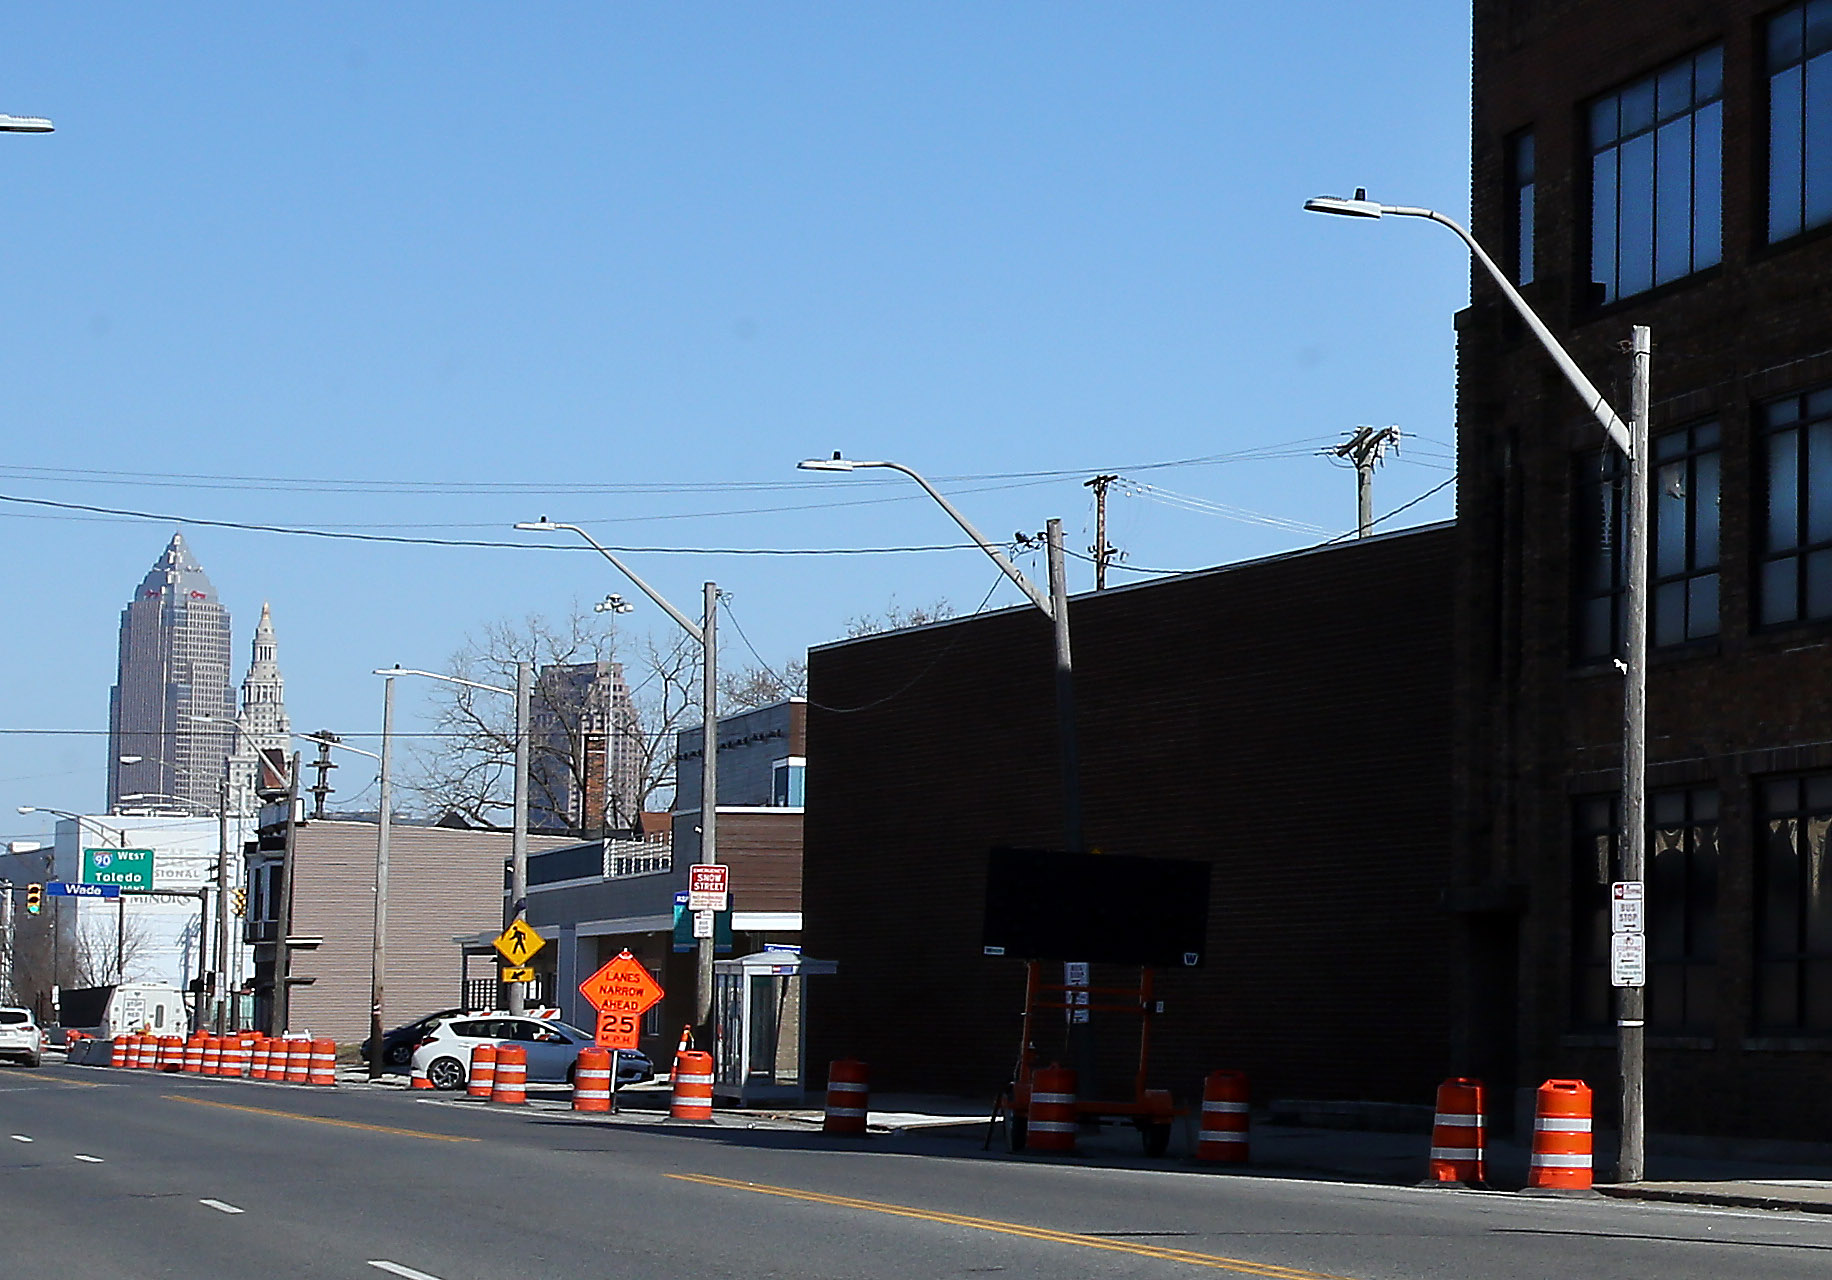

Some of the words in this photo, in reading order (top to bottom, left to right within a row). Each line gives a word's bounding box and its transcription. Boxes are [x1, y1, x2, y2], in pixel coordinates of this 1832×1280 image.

[95, 856, 111, 866] 90
[117, 851, 145, 860] WEST
[95, 872, 142, 882] Toledo
[697, 874, 722, 882] SNOW
[65, 884, 102, 895] Wade
[693, 882, 724, 891] STREET
[1620, 903, 1636, 912] BUS
[1619, 913, 1638, 922] STOP
[605, 972, 640, 983] LANES
[599, 985, 644, 997] NARROW
[601, 999, 638, 1010] AHEAD
[602, 1015, 634, 1033] 25
